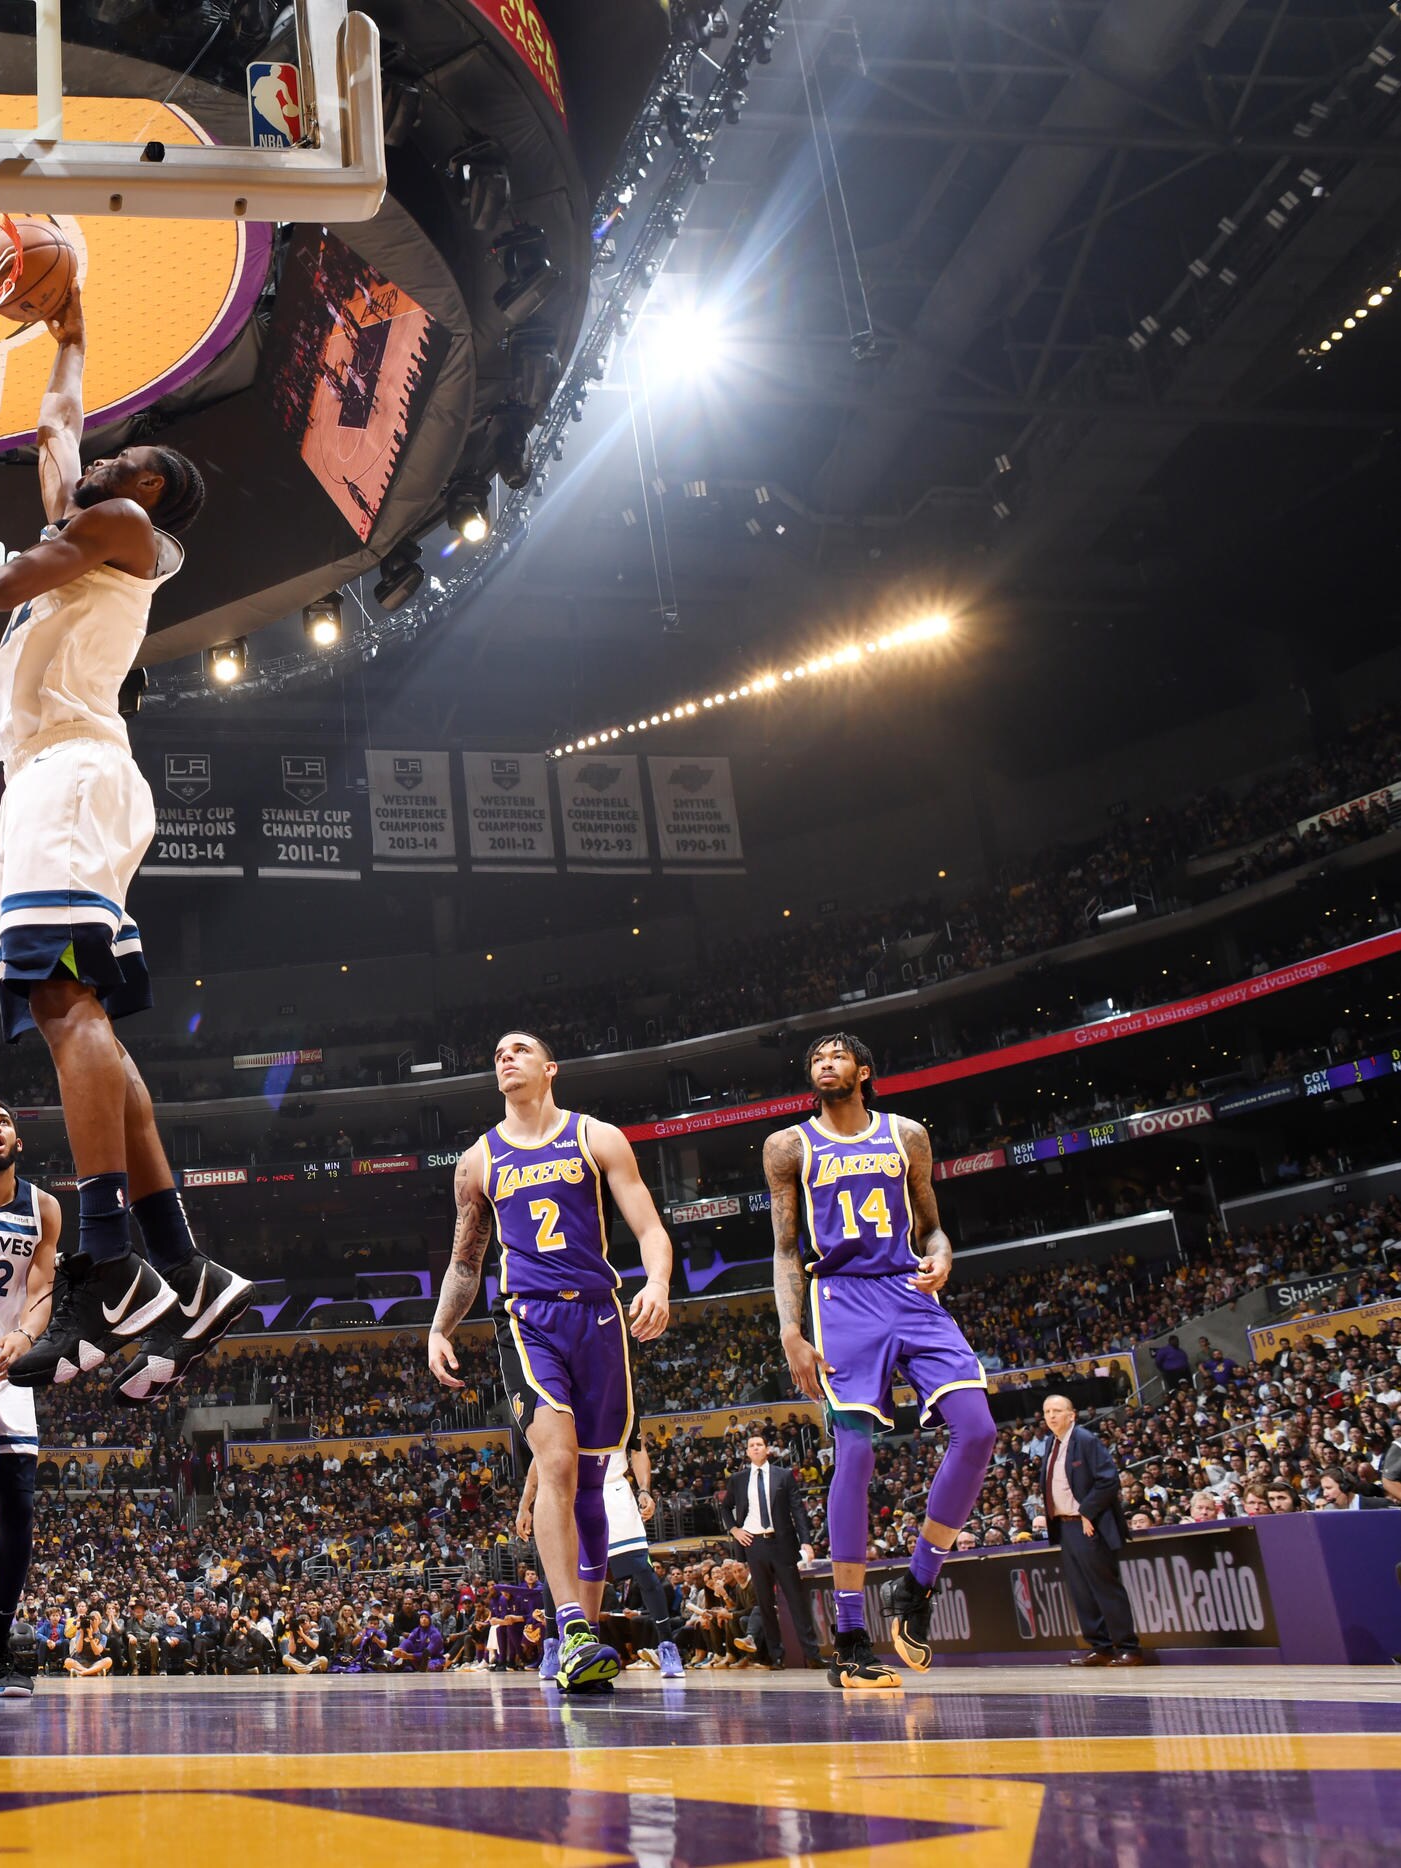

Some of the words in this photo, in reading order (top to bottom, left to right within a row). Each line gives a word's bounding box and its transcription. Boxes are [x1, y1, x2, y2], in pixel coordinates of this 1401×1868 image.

[169, 759, 207, 776] LA
[286, 760, 323, 777] LA
[394, 761, 422, 773] LA
[492, 761, 520, 774] LA
[382, 794, 438, 807] WESTERN
[479, 795, 536, 807] WESTERN
[572, 796, 632, 809] CAMPBELL
[673, 798, 718, 810] SMYTHE
[155, 808, 202, 821] TANLEY
[206, 807, 235, 820] CUP
[261, 808, 320, 823] STANLEY
[323, 810, 352, 823] CUP
[374, 807, 448, 819] CONFERENCE
[473, 807, 547, 820] CONFERENCE
[567, 808, 641, 822] CONFERENCE
[671, 810, 723, 822] DIVISION
[155, 822, 237, 837] HAMPIONS
[261, 823, 353, 839] CHAMPIONS
[378, 821, 446, 833] CHAMPIONS
[477, 821, 544, 833] CHAMPIONS
[571, 821, 638, 834] CHAMPIONS
[665, 823, 732, 836] CHAMPIONS
[158, 841, 226, 860] 2013-14
[388, 837, 438, 850] 2013-14
[488, 837, 537, 850] 2011-12
[579, 837, 634, 852] 1992-93
[676, 838, 728, 852] 1990-91
[277, 844, 341, 862] 2011-12
[1074, 1027, 1108, 1044] Give
[1111, 1018, 1142, 1037] your
[1144, 1001, 1209, 1027] business
[1210, 986, 1248, 1007] every
[1303, 1069, 1328, 1085] CGY
[1219, 1097, 1257, 1112] AMERICAN
[1257, 1087, 1291, 1101] EXPRESS
[654, 1122, 684, 1135] Give
[686, 1118, 712, 1133] your
[713, 1106, 768, 1125] business
[770, 1098, 804, 1115] every
[1127, 1105, 1212, 1137] TOYOTA
[1091, 1136, 1115, 1147] NHL
[373, 1160, 410, 1170] McDonald's
[1015, 1153, 1037, 1165] COL
[303, 1163, 319, 1172] LAL
[324, 1162, 340, 1171] MIN
[813, 1152, 902, 1188] LAKERS
[184, 1170, 247, 1185] TOSHIBA
[494, 1157, 585, 1202] LAKERS
[673, 1202, 739, 1222] STAPLES
[837, 1187, 894, 1240] 14
[528, 1198, 567, 1253] 2
[1251, 1331, 1276, 1349] 118
[1178, 1551, 1266, 1633] Radio
